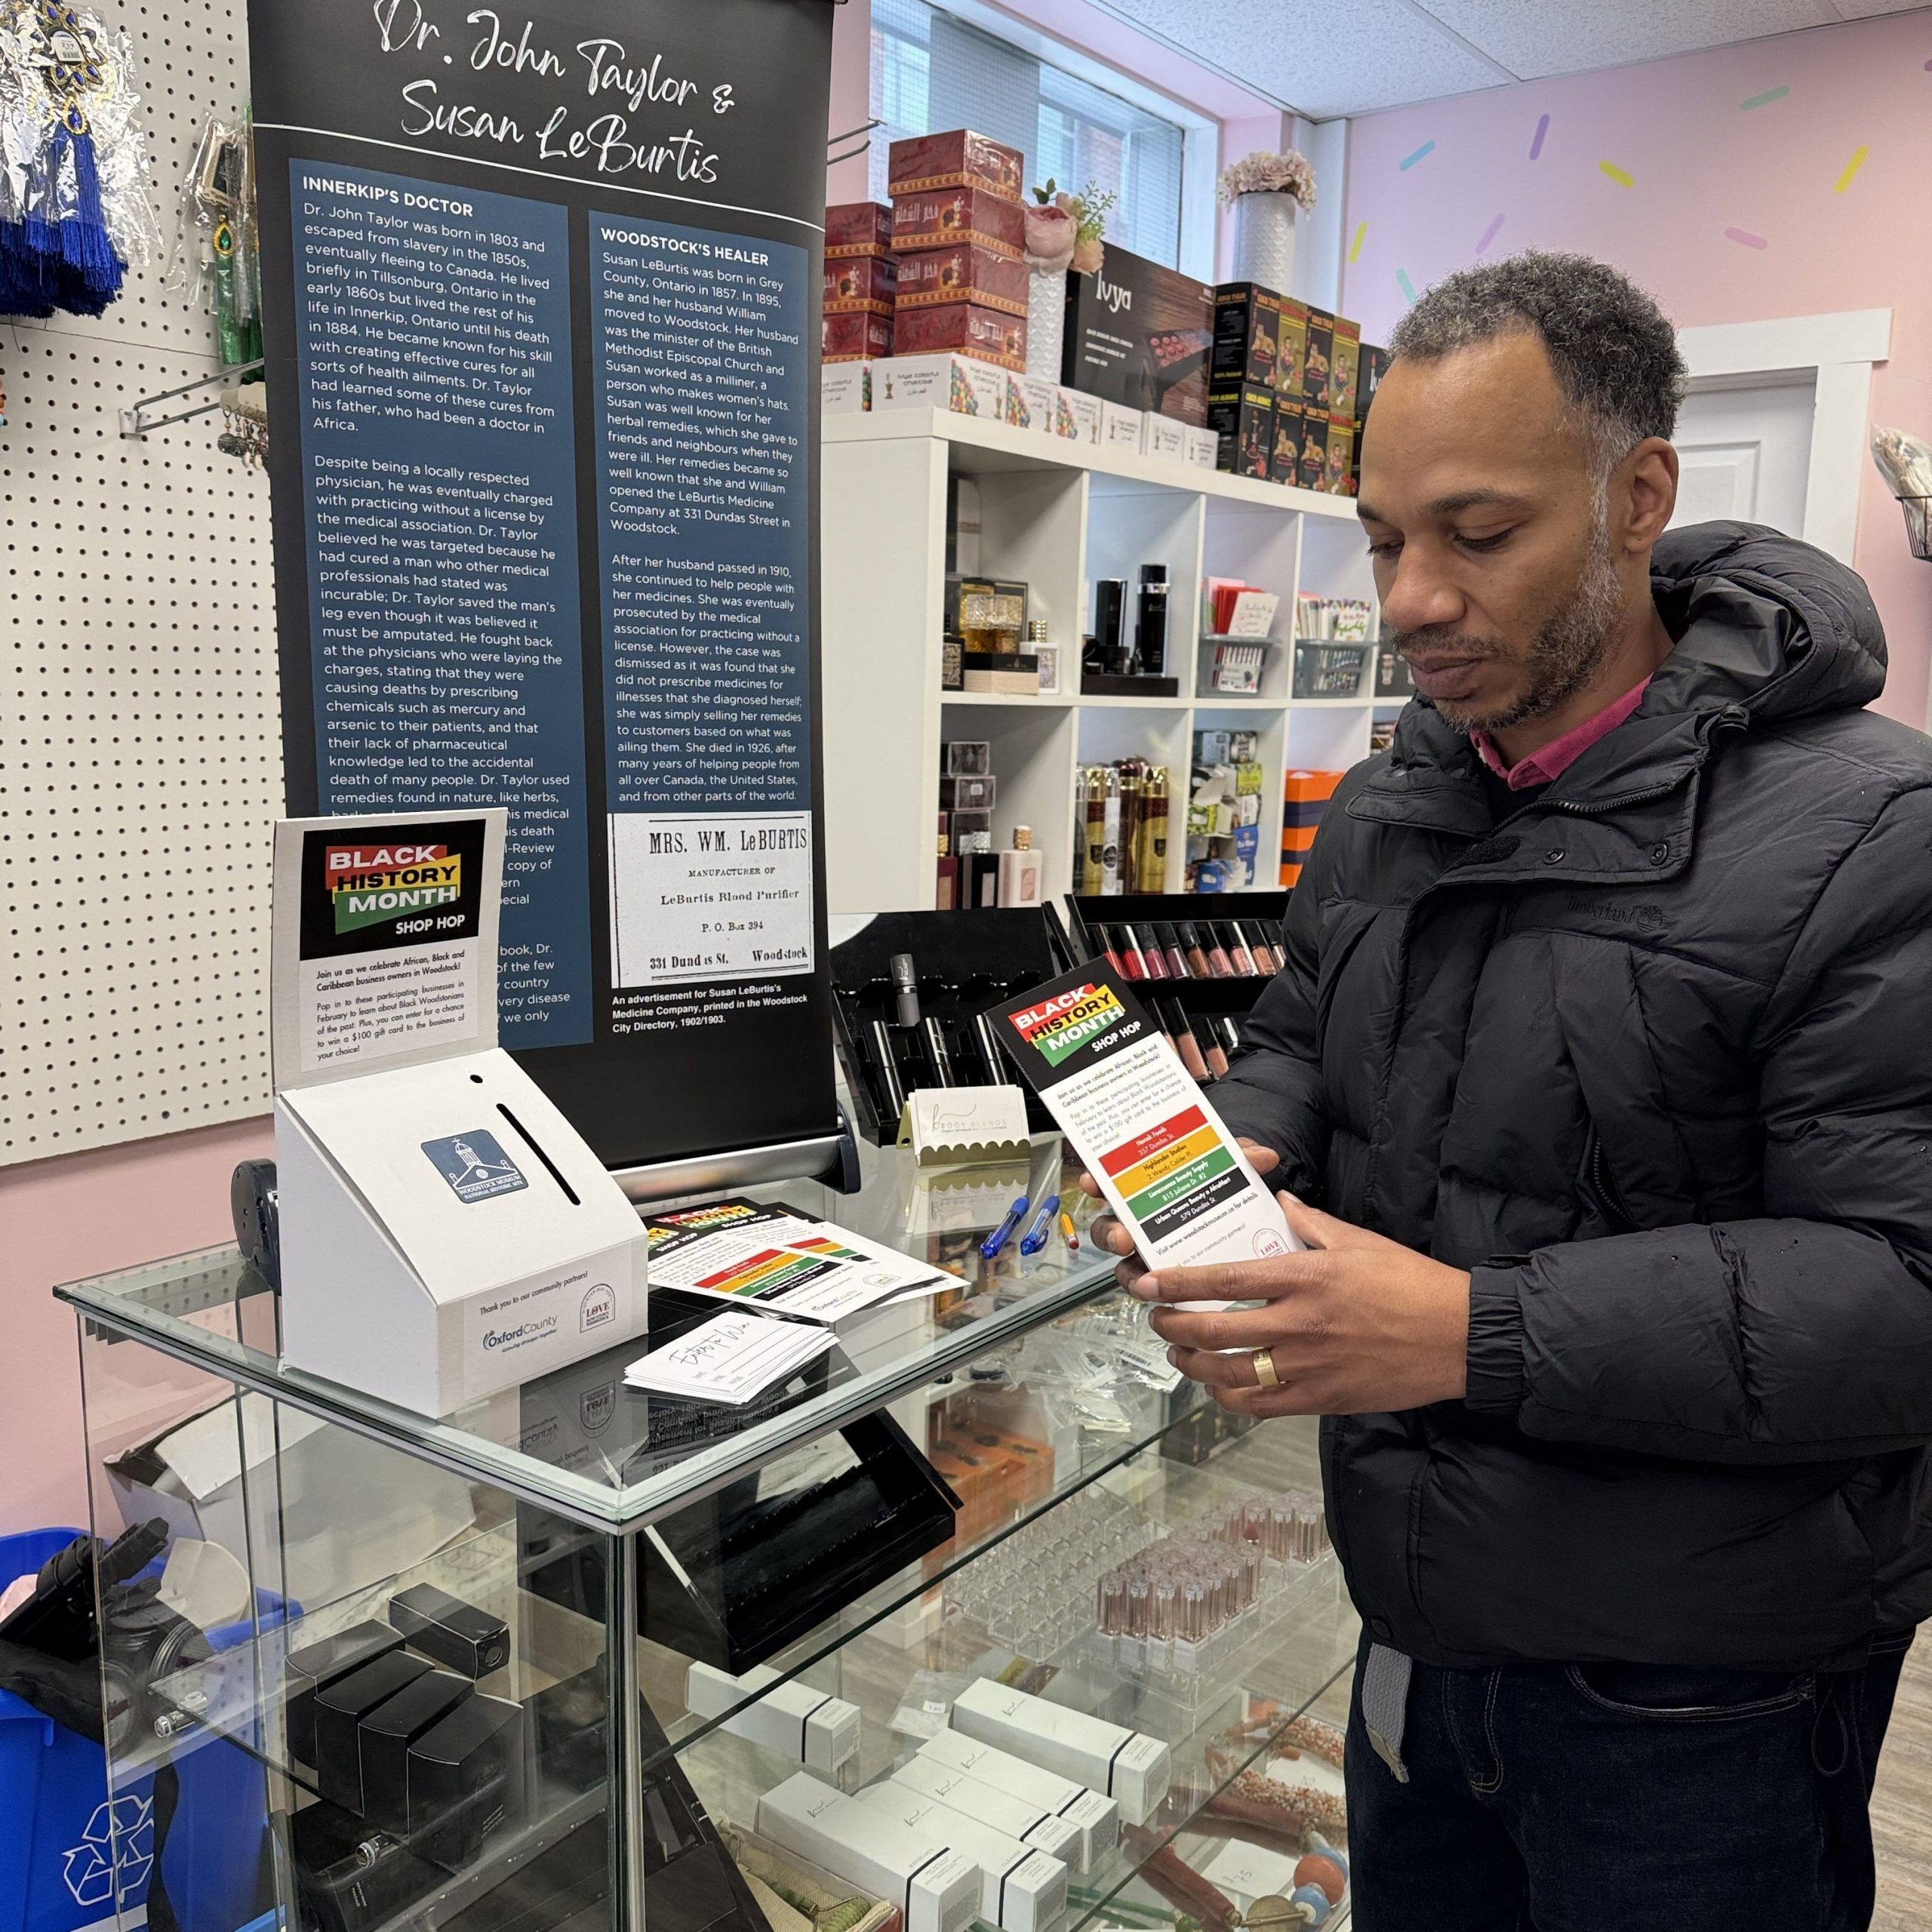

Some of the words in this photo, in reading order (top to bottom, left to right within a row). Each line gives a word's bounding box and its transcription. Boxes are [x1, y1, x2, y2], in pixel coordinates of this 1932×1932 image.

[374, 0, 452, 65] Dr.
[467, 10, 565, 76] John
[577, 38, 697, 112] Taylor
[712, 85, 734, 113] &
[401, 79, 524, 143] Susan
[536, 106, 718, 183] LeBurtis
[303, 176, 398, 203] INNERKIP'S
[404, 192, 472, 217] DOCTOR
[304, 202, 324, 215] Dr.
[328, 206, 362, 221] John
[366, 211, 408, 229] Taylor
[412, 222, 437, 234] was
[441, 223, 471, 239] born
[475, 229, 485, 242] in
[489, 232, 518, 248] 1803
[522, 241, 544, 252] and
[304, 224, 362, 241] escaped
[367, 230, 398, 246] from
[403, 237, 448, 256] slavery
[452, 245, 463, 257] in
[467, 248, 488, 261] the
[491, 251, 529, 269] 1850s,
[601, 227, 710, 257] WOODSTOCK'S
[714, 245, 768, 266] HEALER
[602, 251, 638, 267] Susan
[641, 257, 688, 275] LeBurtis
[691, 268, 713, 278] was
[717, 269, 743, 283] born
[746, 274, 755, 285] in
[758, 276, 783, 291] Grey
[603, 269, 648, 288] County,
[652, 277, 695, 293] Ontario
[698, 284, 708, 295] in
[711, 286, 739, 300] 1857.
[742, 291, 752, 302] In
[755, 292, 780, 308] 1895,
[650, 833, 687, 854] MRS.
[698, 831, 730, 851] WM.
[741, 829, 807, 851] LeBURTIS
[330, 844, 438, 870] BLACK
[337, 866, 457, 891] HISTORY
[688, 867, 761, 877] MANUFACTURER
[349, 887, 457, 913] MONTH
[661, 894, 714, 905] LeBurtis
[756, 891, 799, 900] Purifier
[395, 919, 433, 934] SHOP
[437, 915, 465, 930] HOP
[702, 924, 711, 932] P.
[715, 923, 724, 932] O.
[728, 922, 745, 931] Box
[748, 921, 764, 930] 394
[315, 969, 331, 979] Join
[369, 960, 401, 971] celebrate
[402, 956, 429, 966] African,
[432, 951, 450, 961] Black
[451, 949, 465, 958] and
[650, 958, 666, 969] 331
[716, 953, 729, 964] St.
[752, 947, 808, 961] Woodstock
[316, 980, 354, 991] Caribbean
[355, 975, 385, 986] business
[386, 971, 411, 980] owners
[414, 968, 420, 977] in
[421, 961, 460, 975] Woodstock!
[611, 995, 625, 1005] An
[627, 990, 692, 1004] advertisement
[694, 989, 707, 998] for
[709, 988, 736, 997] Susan
[738, 983, 781, 995] LeBurtis's
[612, 1008, 654, 1019] Medicine
[656, 1004, 701, 1015] Company,
[703, 1000, 734, 1013] printed
[736, 999, 744, 1008] in
[746, 998, 760, 1008] the
[761, 993, 808, 1006] Woodstock
[1014, 985, 1092, 1030] BLACK
[612, 1023, 631, 1034] City
[633, 1020, 678, 1031] Directory,
[680, 1014, 726, 1026] 1902/1903.
[1029, 992, 1112, 1040] HISTORY
[1046, 1005, 1125, 1051] MONTH
[1091, 1032, 1119, 1052] SHOP
[1119, 1020, 1141, 1038] HOP
[458, 1181, 497, 1195] WOODSTOCK
[497, 1174, 522, 1186] MUSEUM
[464, 1190, 490, 1200] NATIONAL
[490, 1184, 512, 1194] HISTORIC
[721, 1220, 748, 1228] SHOP
[1154, 1213, 1171, 1224] Urban
[1155, 1245, 1168, 1255] Visit
[1241, 1192, 1258, 1204] details
[479, 1303, 499, 1315] Thank
[500, 1299, 512, 1310] you
[521, 1293, 531, 1303] our
[531, 1281, 563, 1297] community
[564, 1270, 589, 1287] partners!
